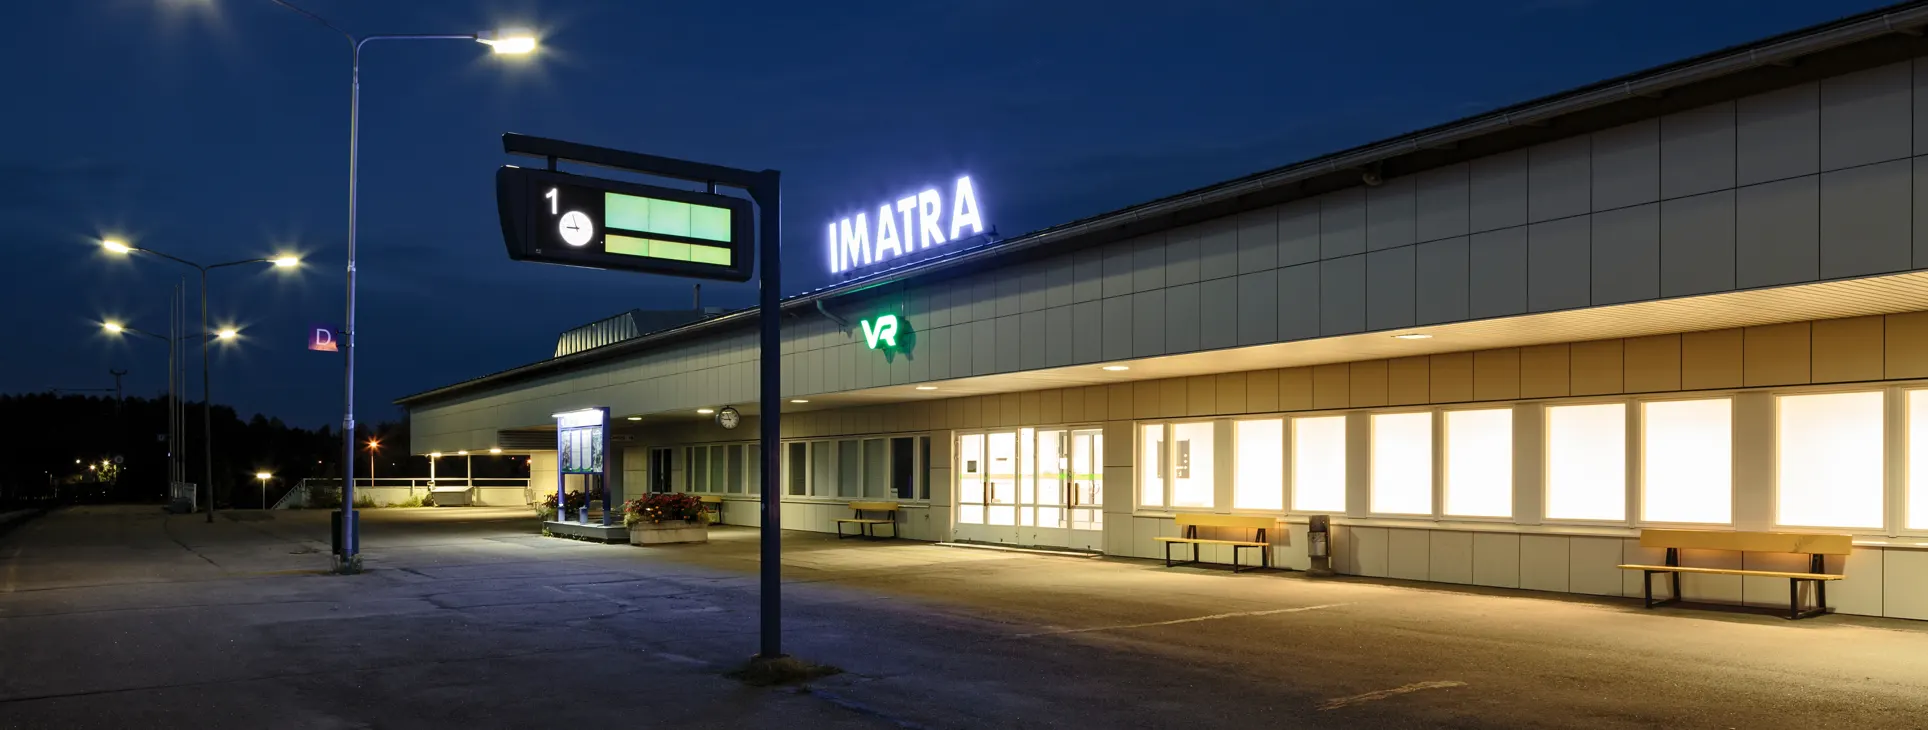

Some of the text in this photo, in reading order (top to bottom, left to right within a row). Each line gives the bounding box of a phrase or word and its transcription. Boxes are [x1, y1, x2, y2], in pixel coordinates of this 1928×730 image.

[545, 187, 558, 215] 1
[829, 176, 983, 273] IMATRA
[316, 328, 331, 346] D
[861, 314, 898, 350] VR
